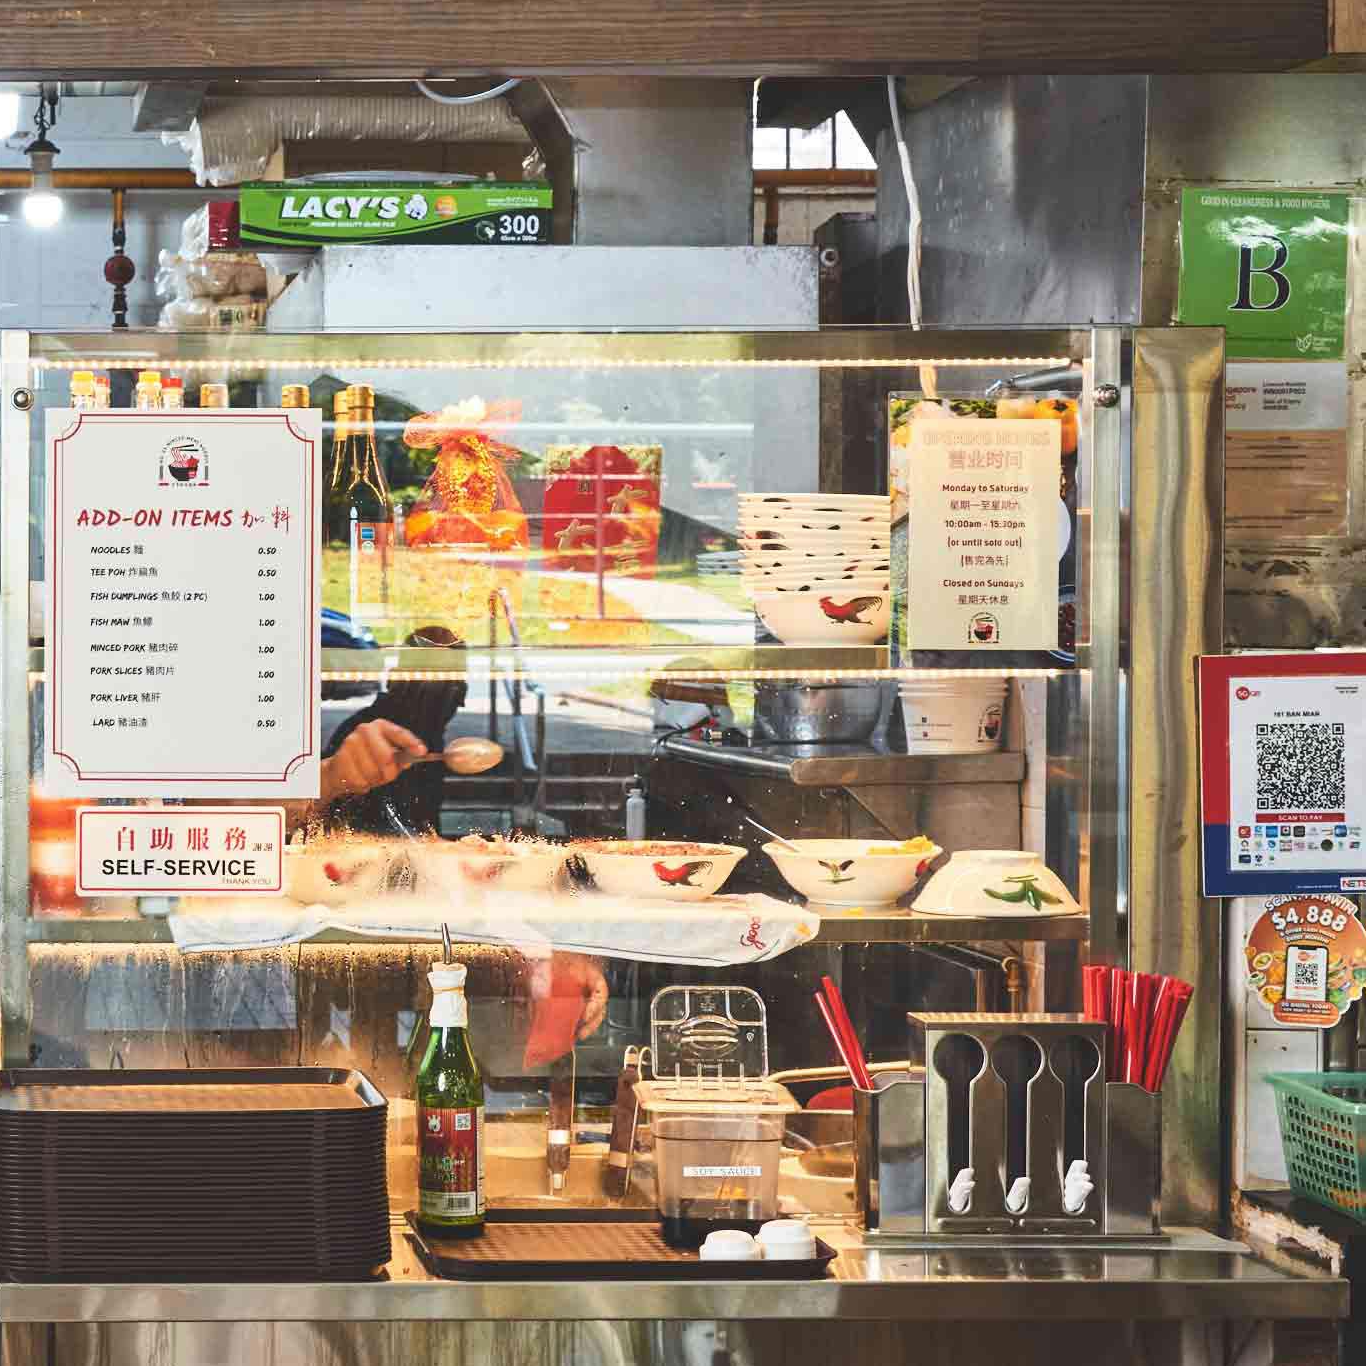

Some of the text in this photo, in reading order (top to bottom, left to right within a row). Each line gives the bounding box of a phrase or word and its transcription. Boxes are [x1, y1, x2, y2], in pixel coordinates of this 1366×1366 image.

[280, 195, 401, 220] LACY'S
[499, 214, 540, 235] 300
[1227, 234, 1291, 311] B
[942, 484, 1029, 494] Monday to Saturday
[77, 509, 162, 528] ADD-ON
[171, 509, 234, 527] ITEMS
[945, 520, 982, 528] 10:00am
[962, 538, 982, 547] until
[984, 538, 1002, 547] sold
[90, 546, 131, 555] NOODLES
[258, 547, 277, 555] 0.50
[90, 568, 106, 577] TEE
[108, 568, 126, 577] POH
[257, 569, 277, 577] 0.50
[943, 579, 972, 588] Closed
[987, 579, 1025, 590] Sundays
[90, 592, 109, 601] FISH
[111, 592, 159, 601] DUMPLINGS
[258, 593, 275, 602] 1.00
[90, 618, 109, 627] FISH
[111, 618, 130, 627] MAW
[258, 619, 275, 627] 1.00
[90, 644, 121, 653] MINCED
[123, 644, 146, 653] PORK
[258, 646, 275, 654] 1.00
[90, 667, 112, 676] PORK
[114, 667, 143, 676] SLICES
[258, 671, 275, 679] 1.00
[90, 693, 112, 702] PORK
[115, 693, 139, 702] LIVER
[93, 718, 115, 727] LARD
[257, 719, 275, 728] 0.50
[117, 826, 247, 851] 自助服務
[102, 859, 256, 876] SELF-SERVICE
[222, 877, 272, 885] THANK YOU
